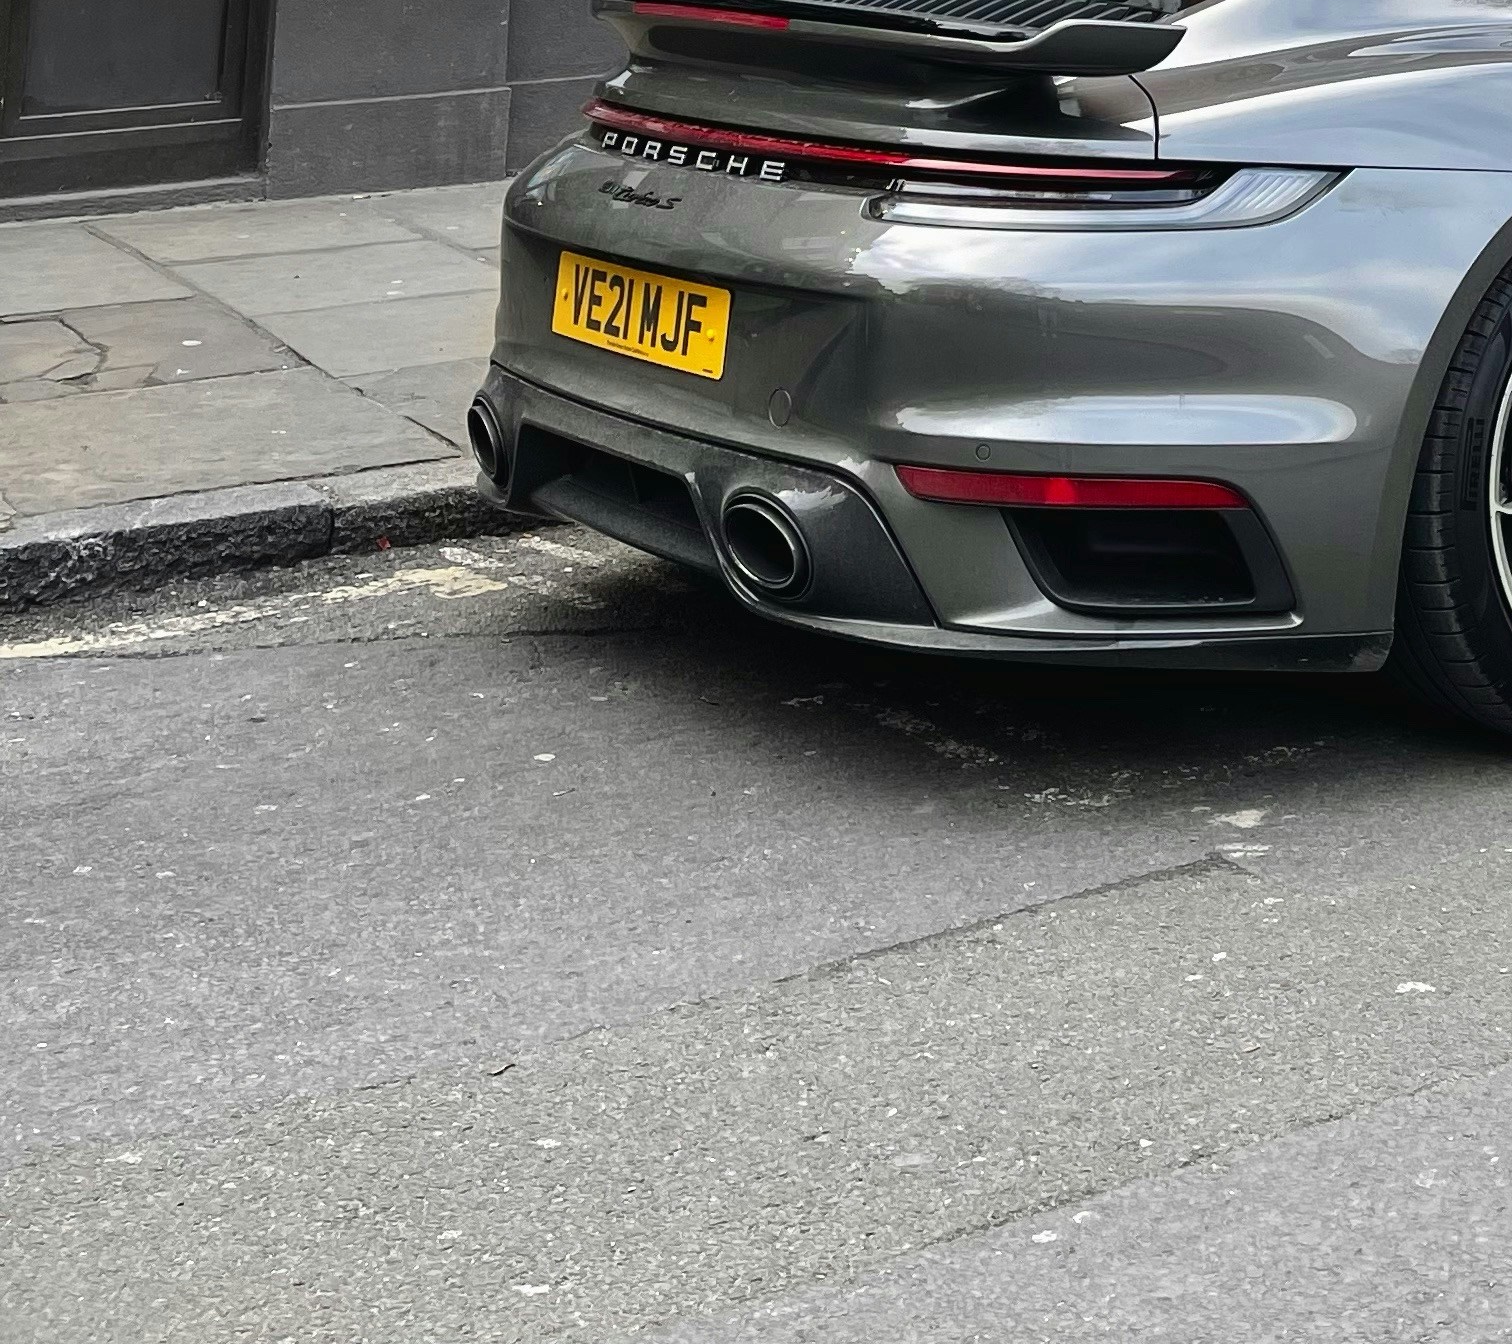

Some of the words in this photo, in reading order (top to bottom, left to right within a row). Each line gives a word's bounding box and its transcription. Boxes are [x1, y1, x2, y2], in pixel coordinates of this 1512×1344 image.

[601, 132, 786, 181] PORSCHE
[573, 264, 635, 341] VE21
[637, 282, 708, 356] MJF
